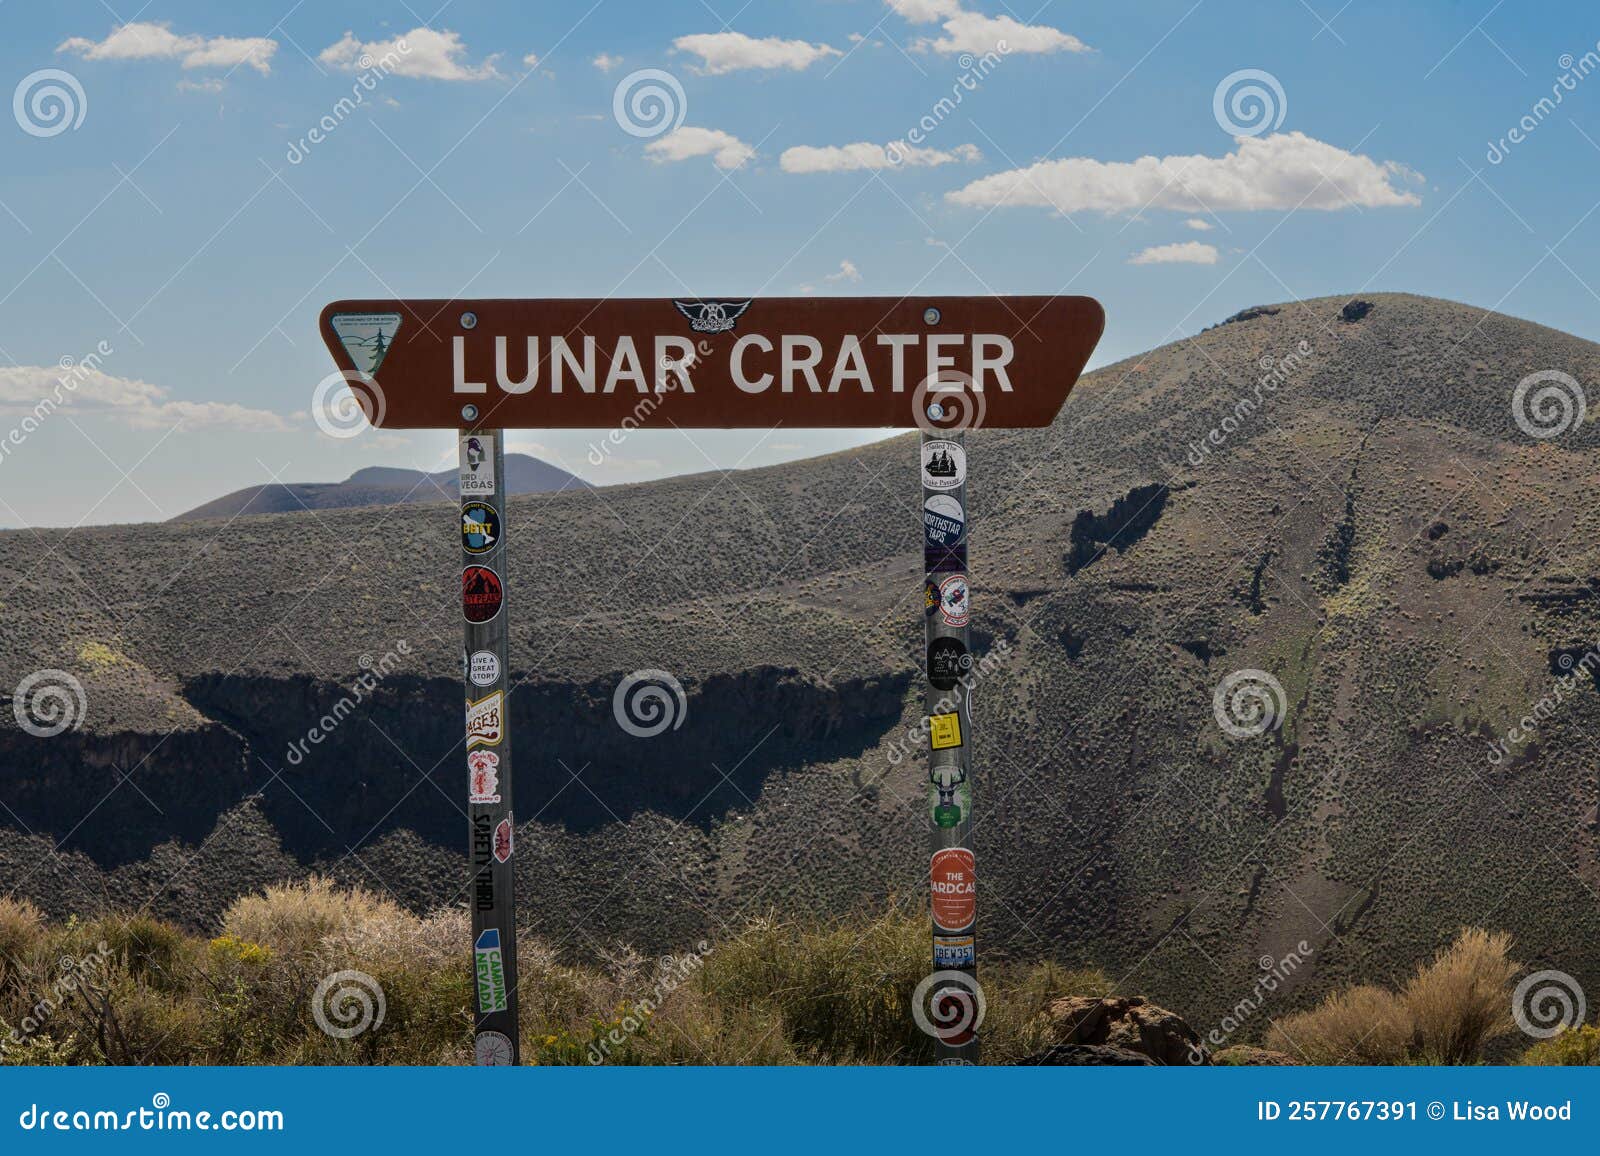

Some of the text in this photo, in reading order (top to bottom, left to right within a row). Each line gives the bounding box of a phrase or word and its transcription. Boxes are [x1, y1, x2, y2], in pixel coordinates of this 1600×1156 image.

[453, 333, 1015, 394] LUNAR CRATER
[461, 480, 493, 489] VEGAS
[924, 511, 961, 536] NORTHSTAR
[929, 527, 947, 544] TAPS
[474, 814, 494, 912] SAFETY THIRD
[945, 872, 964, 881] THE
[476, 952, 493, 1012] NEVADA
[489, 951, 506, 1010] CAMPING
